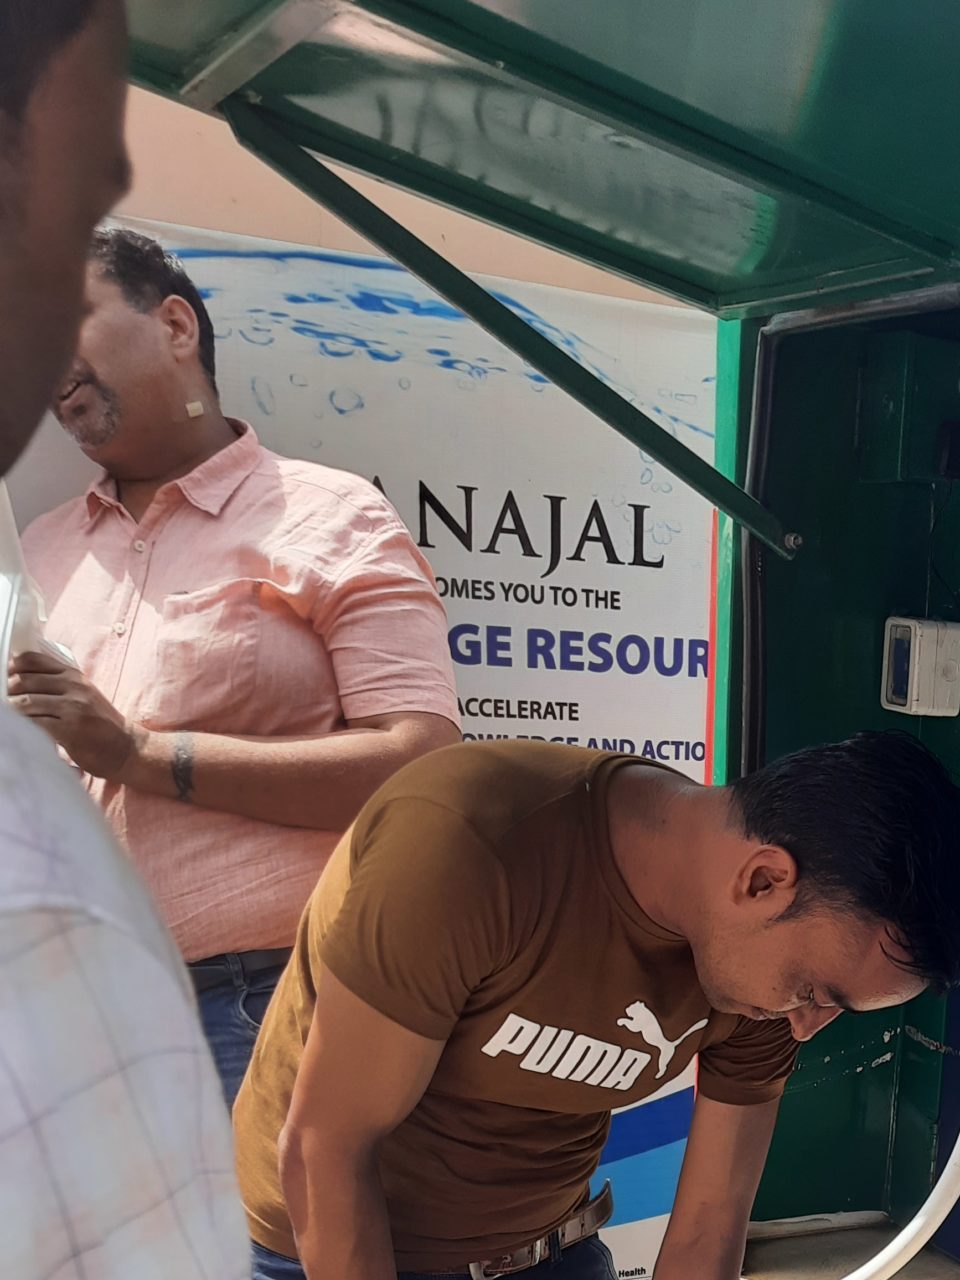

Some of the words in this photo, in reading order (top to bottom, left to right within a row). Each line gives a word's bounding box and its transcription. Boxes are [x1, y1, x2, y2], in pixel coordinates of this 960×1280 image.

[373, 475, 665, 579] NAJAL
[500, 582, 544, 605] YOU
[549, 586, 578, 608] TO
[582, 588, 622, 610] THE
[481, 1012, 652, 1091] PUMA
[618, 1267, 646, 1278] Health
